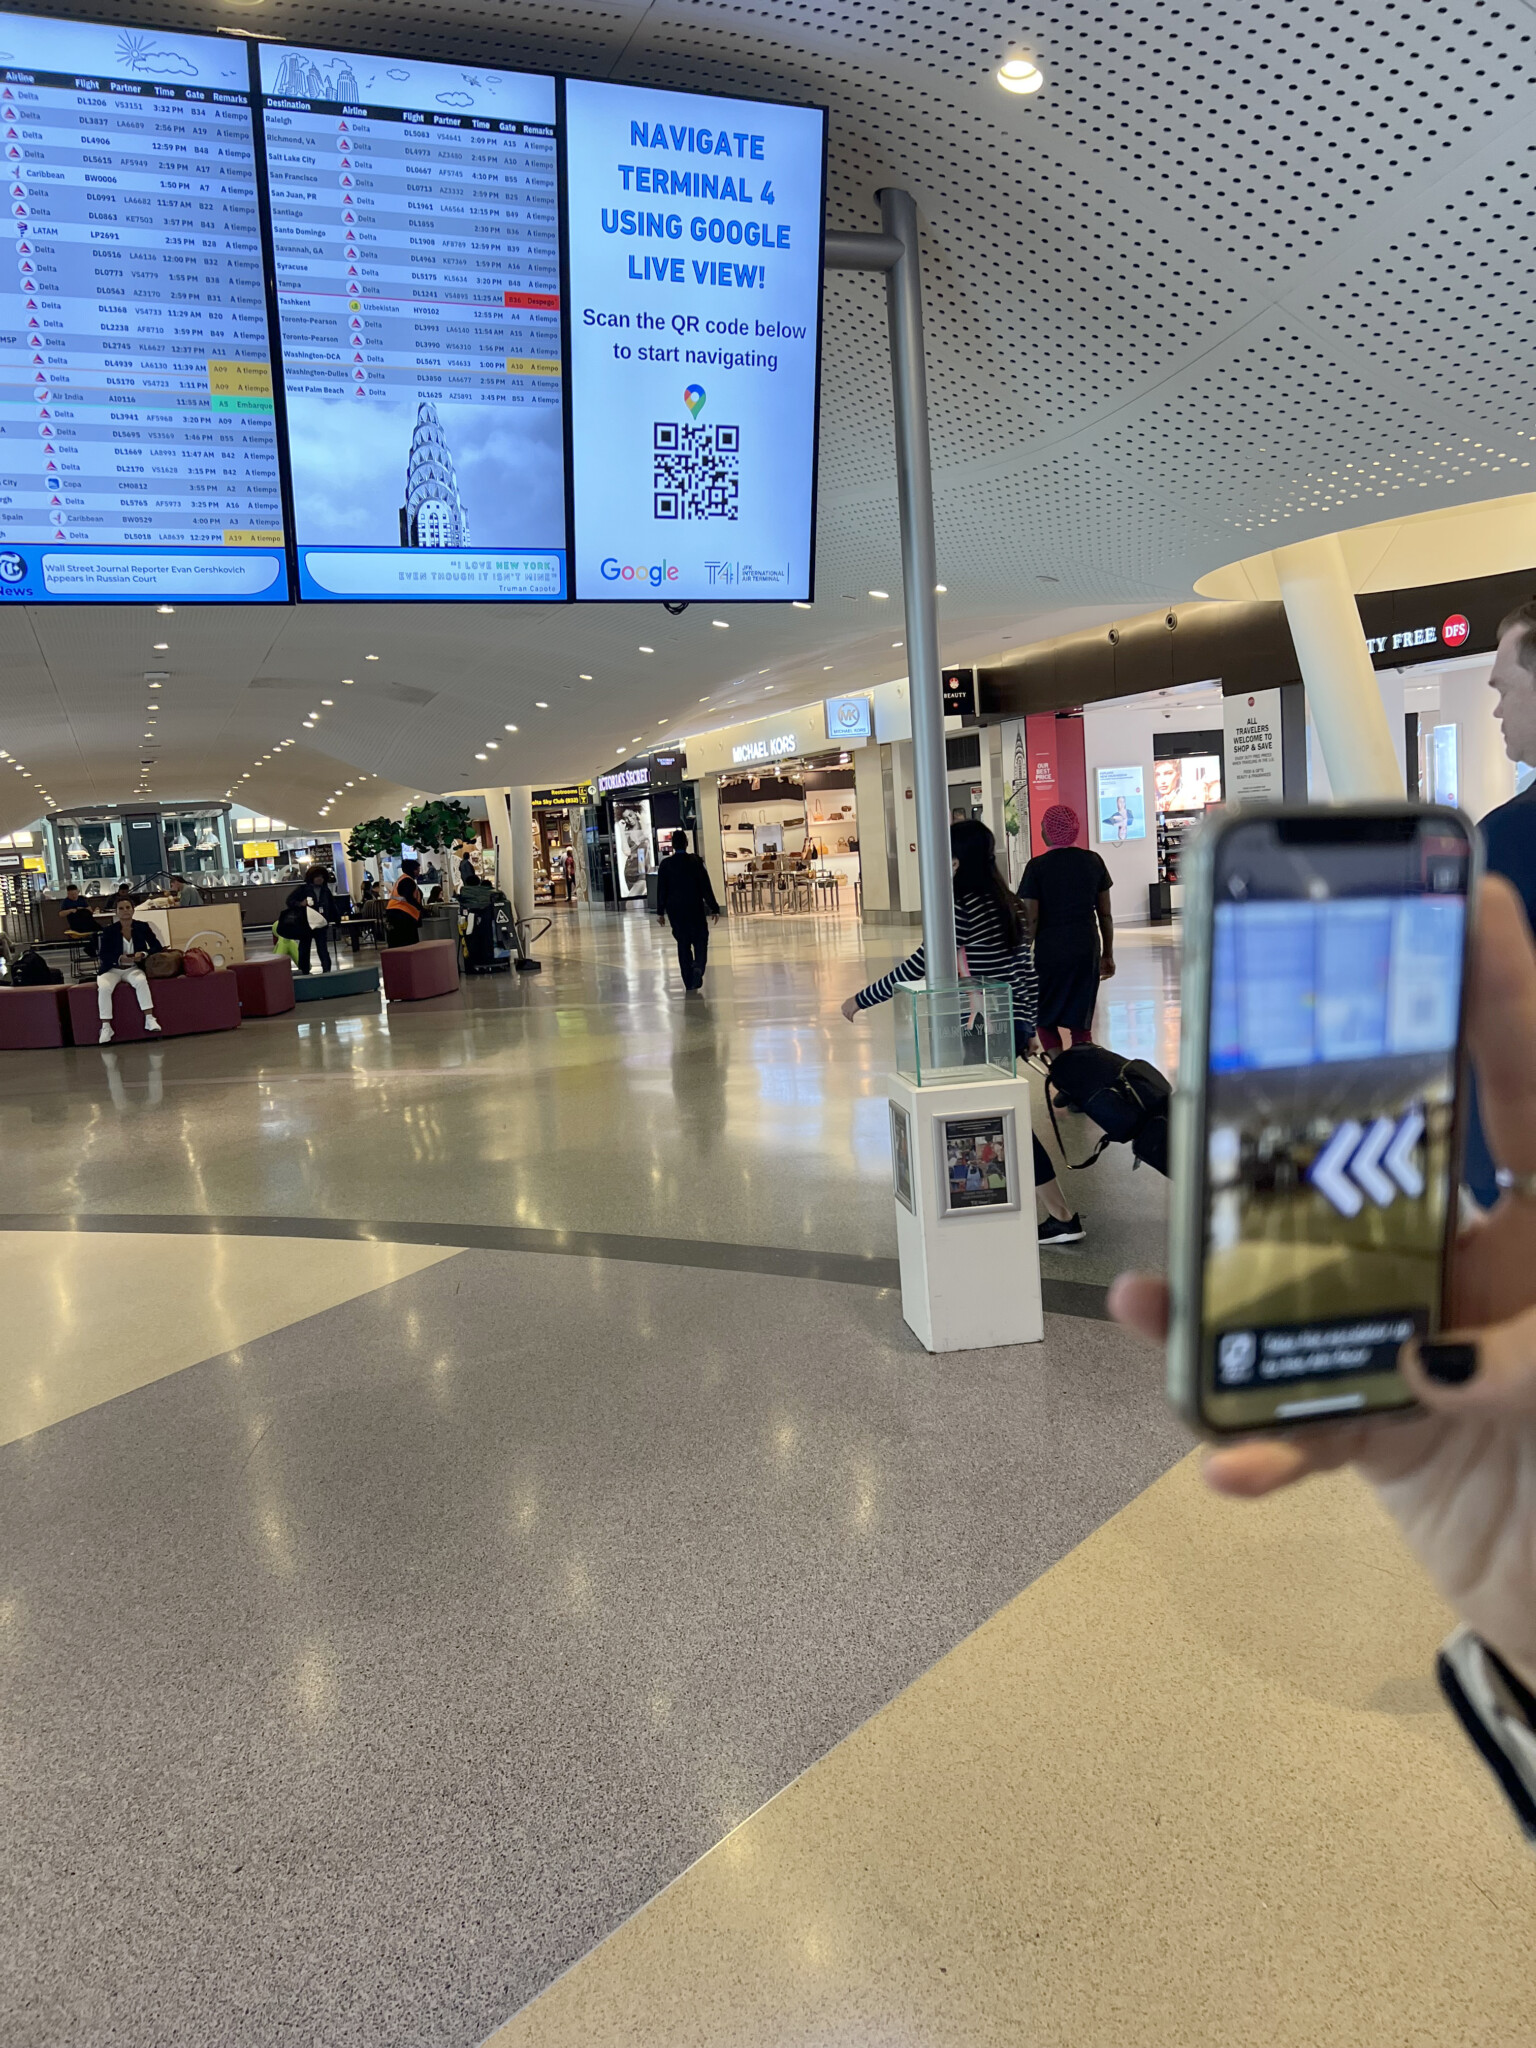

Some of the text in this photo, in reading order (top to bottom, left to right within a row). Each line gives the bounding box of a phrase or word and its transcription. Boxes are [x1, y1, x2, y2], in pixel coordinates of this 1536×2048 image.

[5, 72, 247, 104] Airline Flight Partner Time Gate Remarks
[18, 91, 39, 101] Delta
[77, 97, 107, 107] DL1206
[172, 106, 183, 114] PM
[223, 111, 248, 120] tiempo
[267, 98, 553, 136] Destination Airline Flight Partner Time Gate Remarks
[266, 116, 292, 126] Raleigh
[352, 124, 370, 132] Delta
[486, 138, 497, 146] PM
[532, 142, 553, 152] tiempo
[267, 134, 304, 145] Richmond,
[22, 130, 42, 140] Delta
[81, 136, 110, 145] DL4906
[152, 143, 172, 151] 12:59
[175, 144, 187, 152] PM
[218, 148, 224, 156] A
[226, 149, 251, 159] tiempo
[630, 120, 765, 160] NAVIGATE
[268, 153, 316, 166] Salt Lake City
[26, 169, 65, 179] Caribbean
[85, 174, 117, 184] BW0006
[160, 181, 176, 189] 1:50
[178, 182, 190, 190] PM
[229, 187, 254, 196] tiempo
[285, 173, 318, 182] Francisco
[618, 165, 775, 204] TERMINAL 4
[271, 190, 317, 200] San Juan, PR
[273, 208, 303, 218] Santiago
[274, 226, 326, 238] Santo Domingo
[601, 208, 790, 249] USING GOOGLE
[33, 227, 58, 235] LATAM
[183, 238, 195, 246] PM
[234, 243, 258, 252] tiempo
[276, 244, 309, 255] Savannah,
[277, 263, 308, 272] Syracuse
[629, 255, 765, 288] LIVE VIEW!
[278, 280, 301, 290] Tampa
[280, 298, 399, 313] Tashkent Uzbekistan
[282, 316, 337, 326] Toronto-Pearson
[583, 308, 806, 339] Scan the QR code below
[283, 333, 338, 343] Toronto-Pearson
[284, 350, 340, 361] Washington-DCA
[613, 343, 777, 371] to start navigating
[286, 367, 348, 378] Washington-Dulles
[287, 384, 344, 395] West Palm Beach
[64, 393, 83, 401] India
[45, 565, 245, 575] Wall Street Journal Reporter Evan Gershkovich
[466, 561, 492, 569] LOVE
[496, 561, 519, 569] NEW
[523, 562, 555, 571] YORK,
[399, 572, 427, 580] EVEN
[432, 572, 475, 581] THOUGH
[479, 573, 488, 581] IT
[601, 558, 679, 587] Google
[47, 575, 84, 583] Appears
[97, 575, 130, 583] Russian
[132, 575, 156, 583] Court
[1445, 624, 1465, 638] DFS
[1366, 627, 1437, 653] TY FREE
[840, 709, 857, 720] MK
[1236, 725, 1269, 735] TRAVELERS
[1233, 735, 1263, 744] WELCOME
[732, 734, 796, 763] MICHAEL KORS
[1234, 745, 1249, 753] SHOP
[1258, 742, 1272, 750] SAVE
